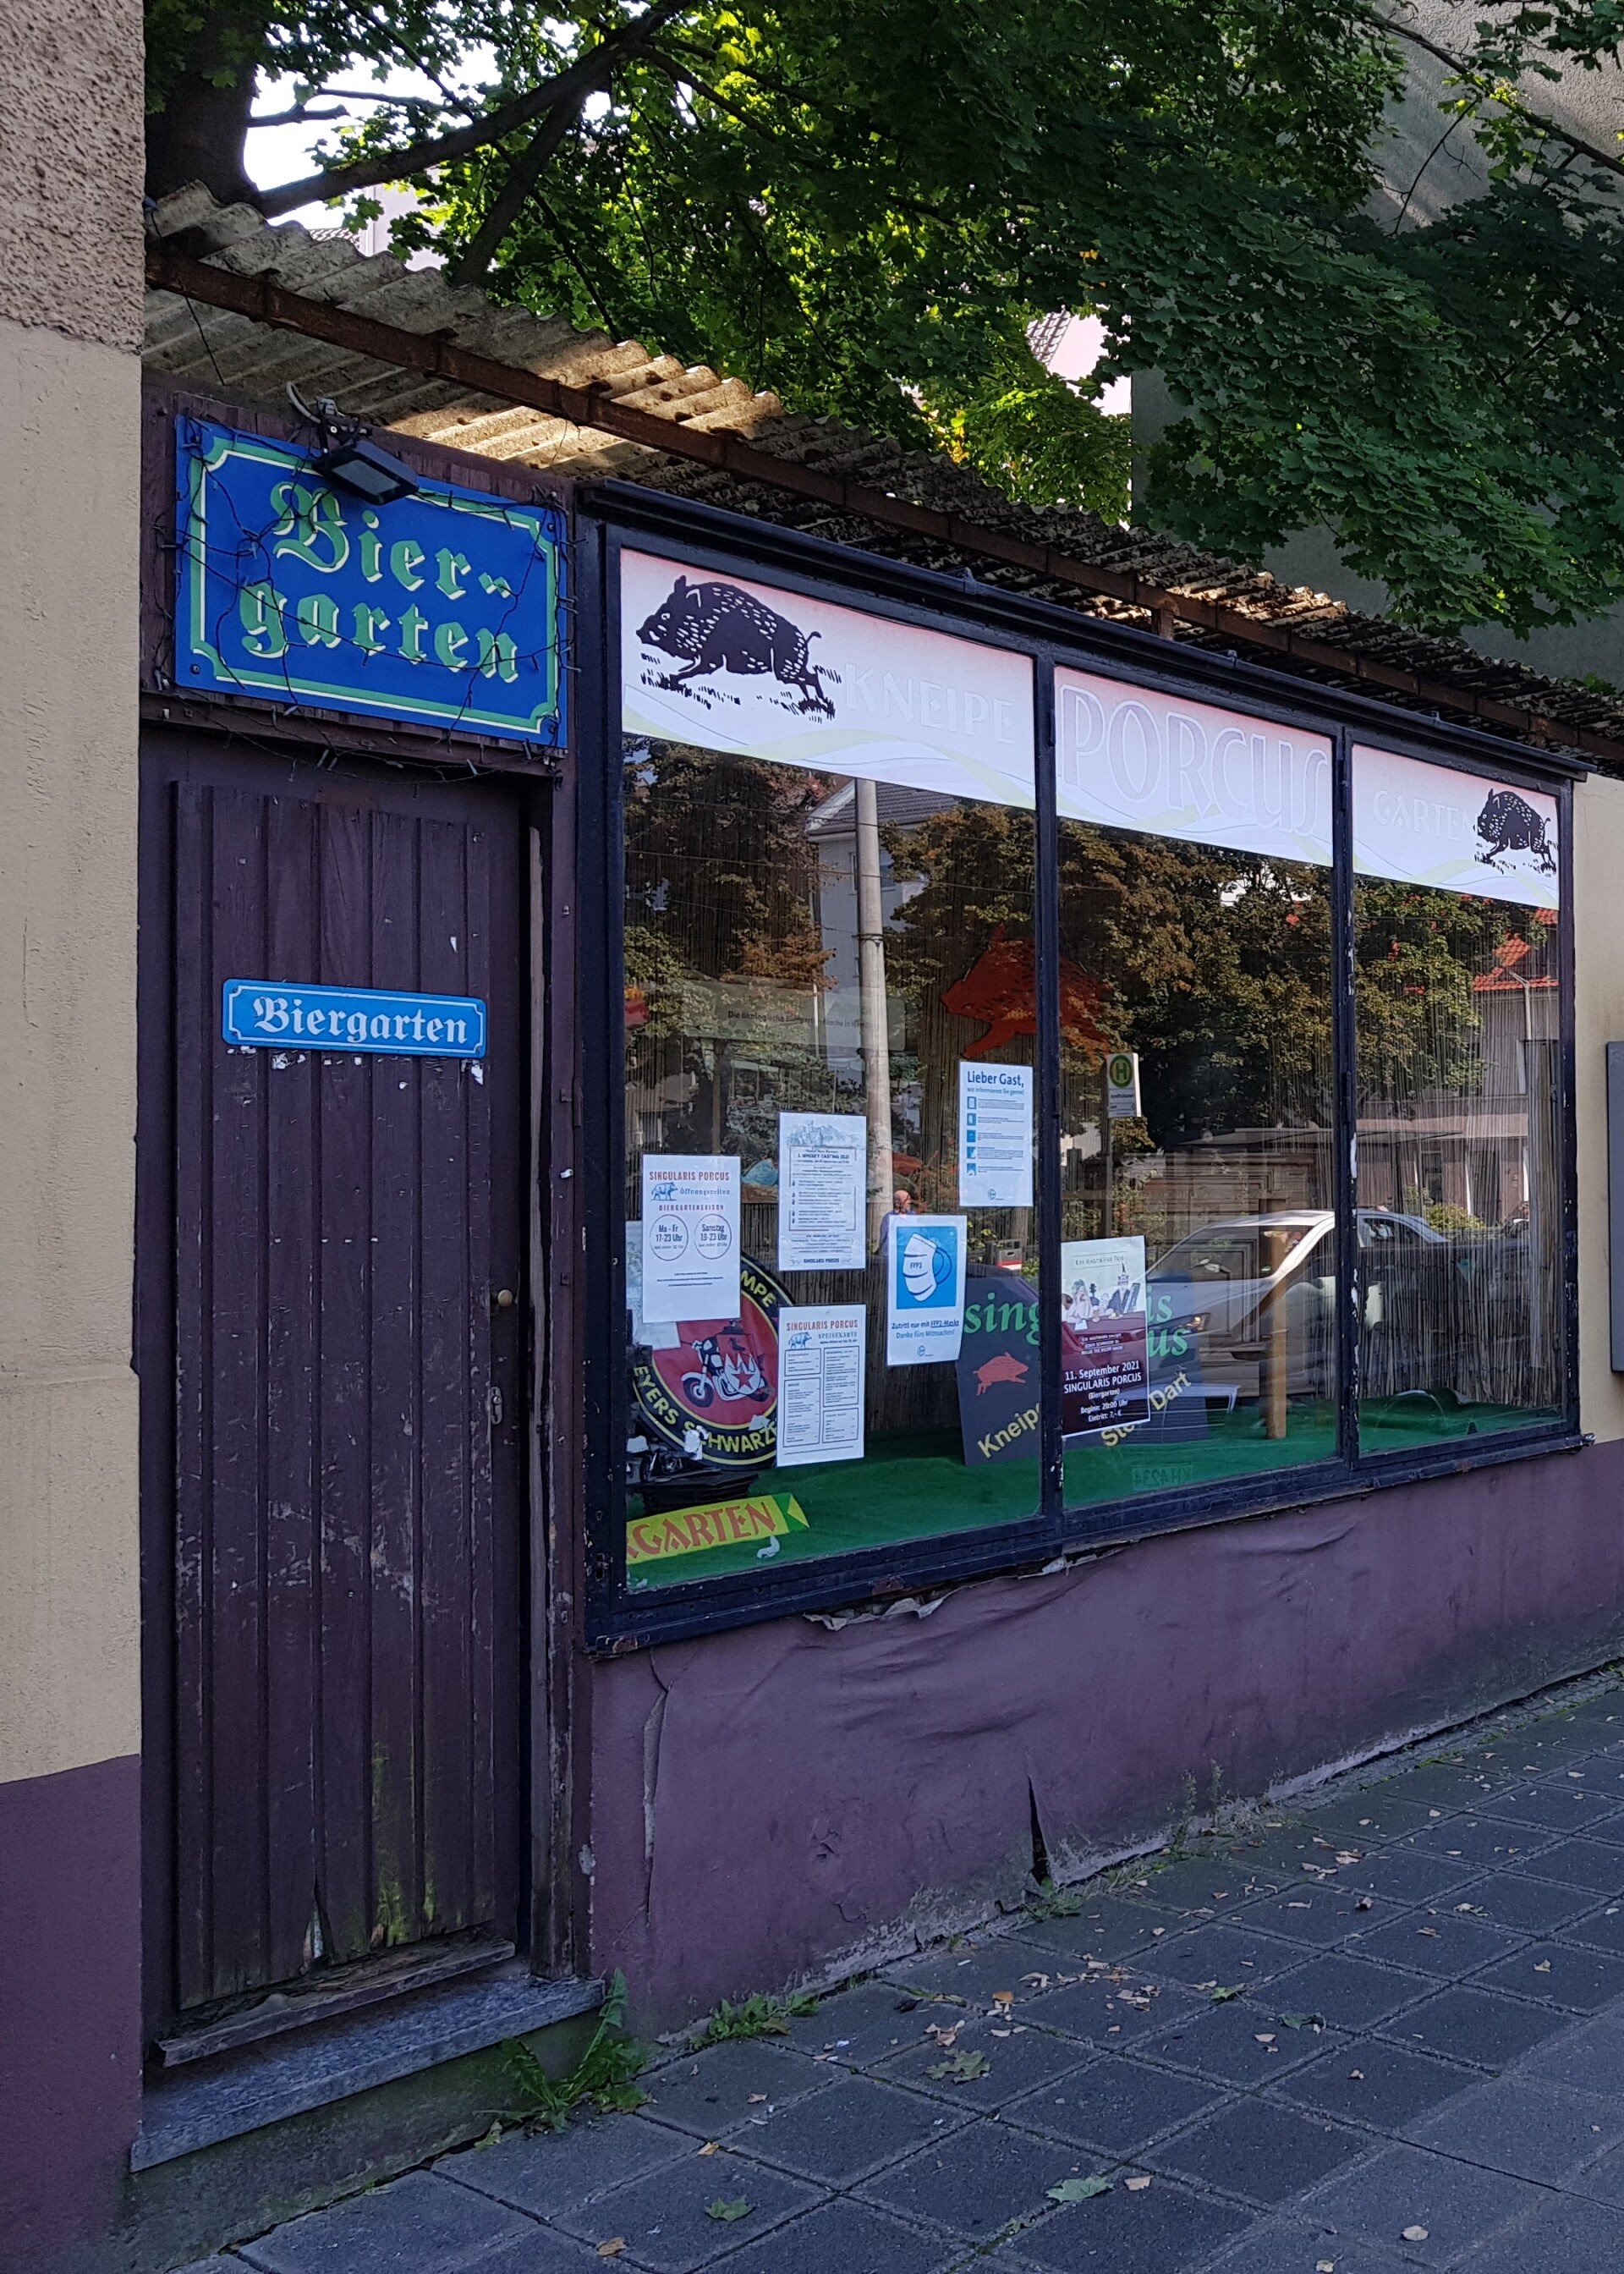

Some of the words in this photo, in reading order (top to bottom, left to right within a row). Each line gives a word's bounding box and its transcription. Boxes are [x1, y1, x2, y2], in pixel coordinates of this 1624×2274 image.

[239, 580, 519, 683] garten
[845, 662, 1013, 745] KNEIPE
[1059, 684, 1329, 838] PORCUS
[254, 995, 468, 1044] Biergarten
[967, 1070, 997, 1084] Lieber
[999, 1073, 1024, 1088] Gast,
[649, 1171, 696, 1181] SINGULARIS
[699, 1172, 730, 1181] PORCUS
[659, 1224, 667, 1233] Mo
[672, 1224, 678, 1233] Fr
[672, 1233, 683, 1242] Uhr
[787, 1321, 828, 1332] SINGULARIS
[830, 1320, 859, 1329] PORCUS
[1065, 1370, 1078, 1381] 11.
[1078, 1364, 1120, 1379] September
[1122, 1359, 1140, 1371] 2021
[1063, 1376, 1111, 1394] SINGULARIS
[1111, 1371, 1142, 1386] PORCUS
[1148, 1370, 1192, 1411] Dart
[627, 1501, 776, 1558] GARTEN
